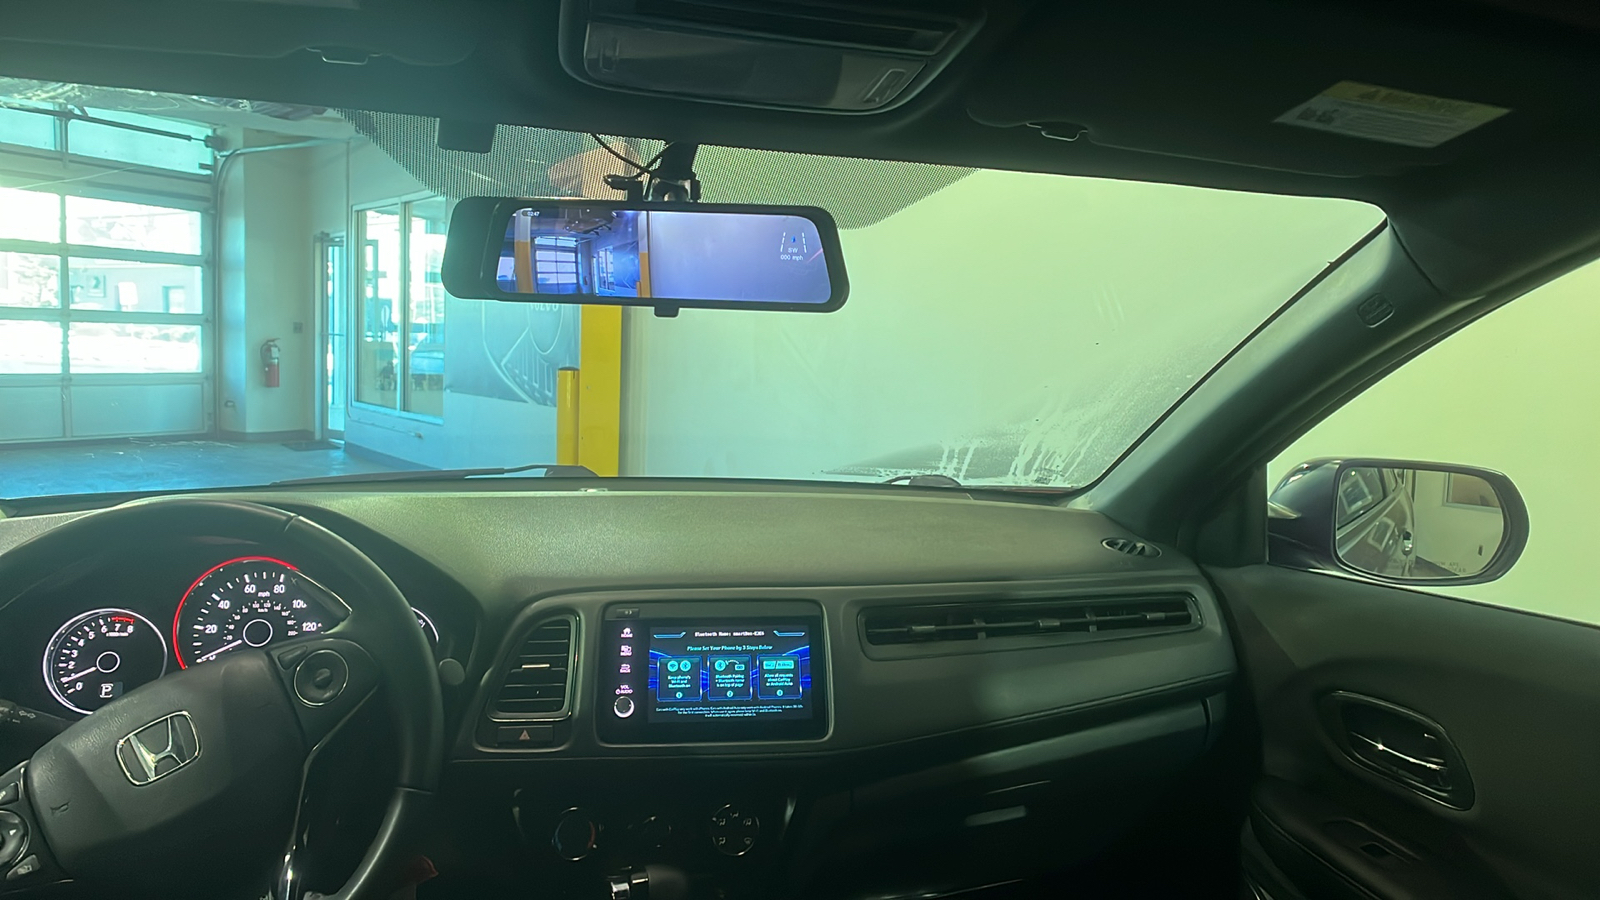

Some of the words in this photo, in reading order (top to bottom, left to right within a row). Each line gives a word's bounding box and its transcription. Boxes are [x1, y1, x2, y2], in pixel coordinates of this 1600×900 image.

[244, 584, 256, 594] 60
[273, 584, 285, 594] 80
[218, 600, 230, 609] 40
[292, 600, 307, 608] 100
[101, 625, 108, 633] 6
[127, 625, 134, 634] 8
[205, 624, 217, 633] 20
[302, 622, 317, 631] 120
[88, 631, 95, 639] 5
[78, 639, 85, 647] 4
[71, 649, 78, 658] 3
[68, 661, 75, 669] 2
[75, 682, 83, 690] 0
[101, 685, 112, 696] P
